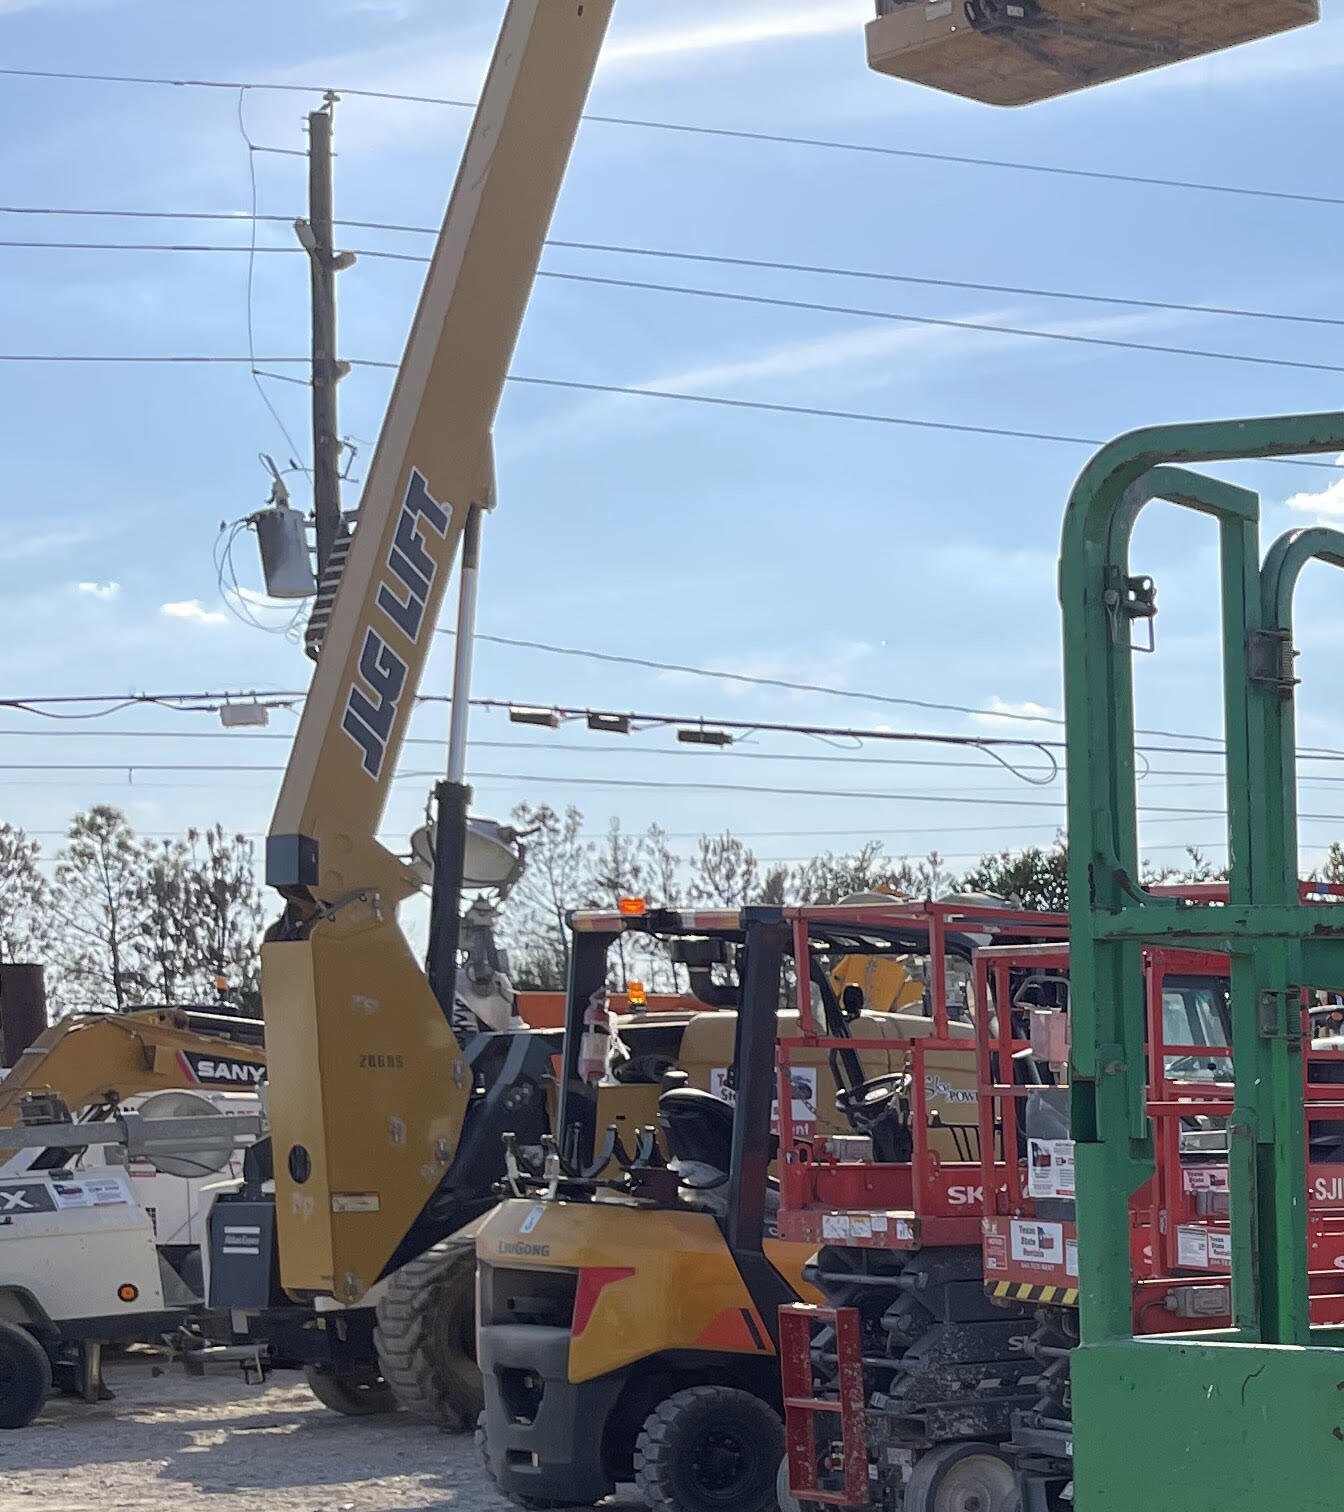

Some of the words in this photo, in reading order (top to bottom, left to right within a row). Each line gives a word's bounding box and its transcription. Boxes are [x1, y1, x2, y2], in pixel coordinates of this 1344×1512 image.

[340, 625, 409, 781] JLG
[375, 465, 451, 645] LIFT
[197, 1060, 266, 1082] SANY
[950, 1089, 979, 1104] POW
[947, 1185, 984, 1205] SK
